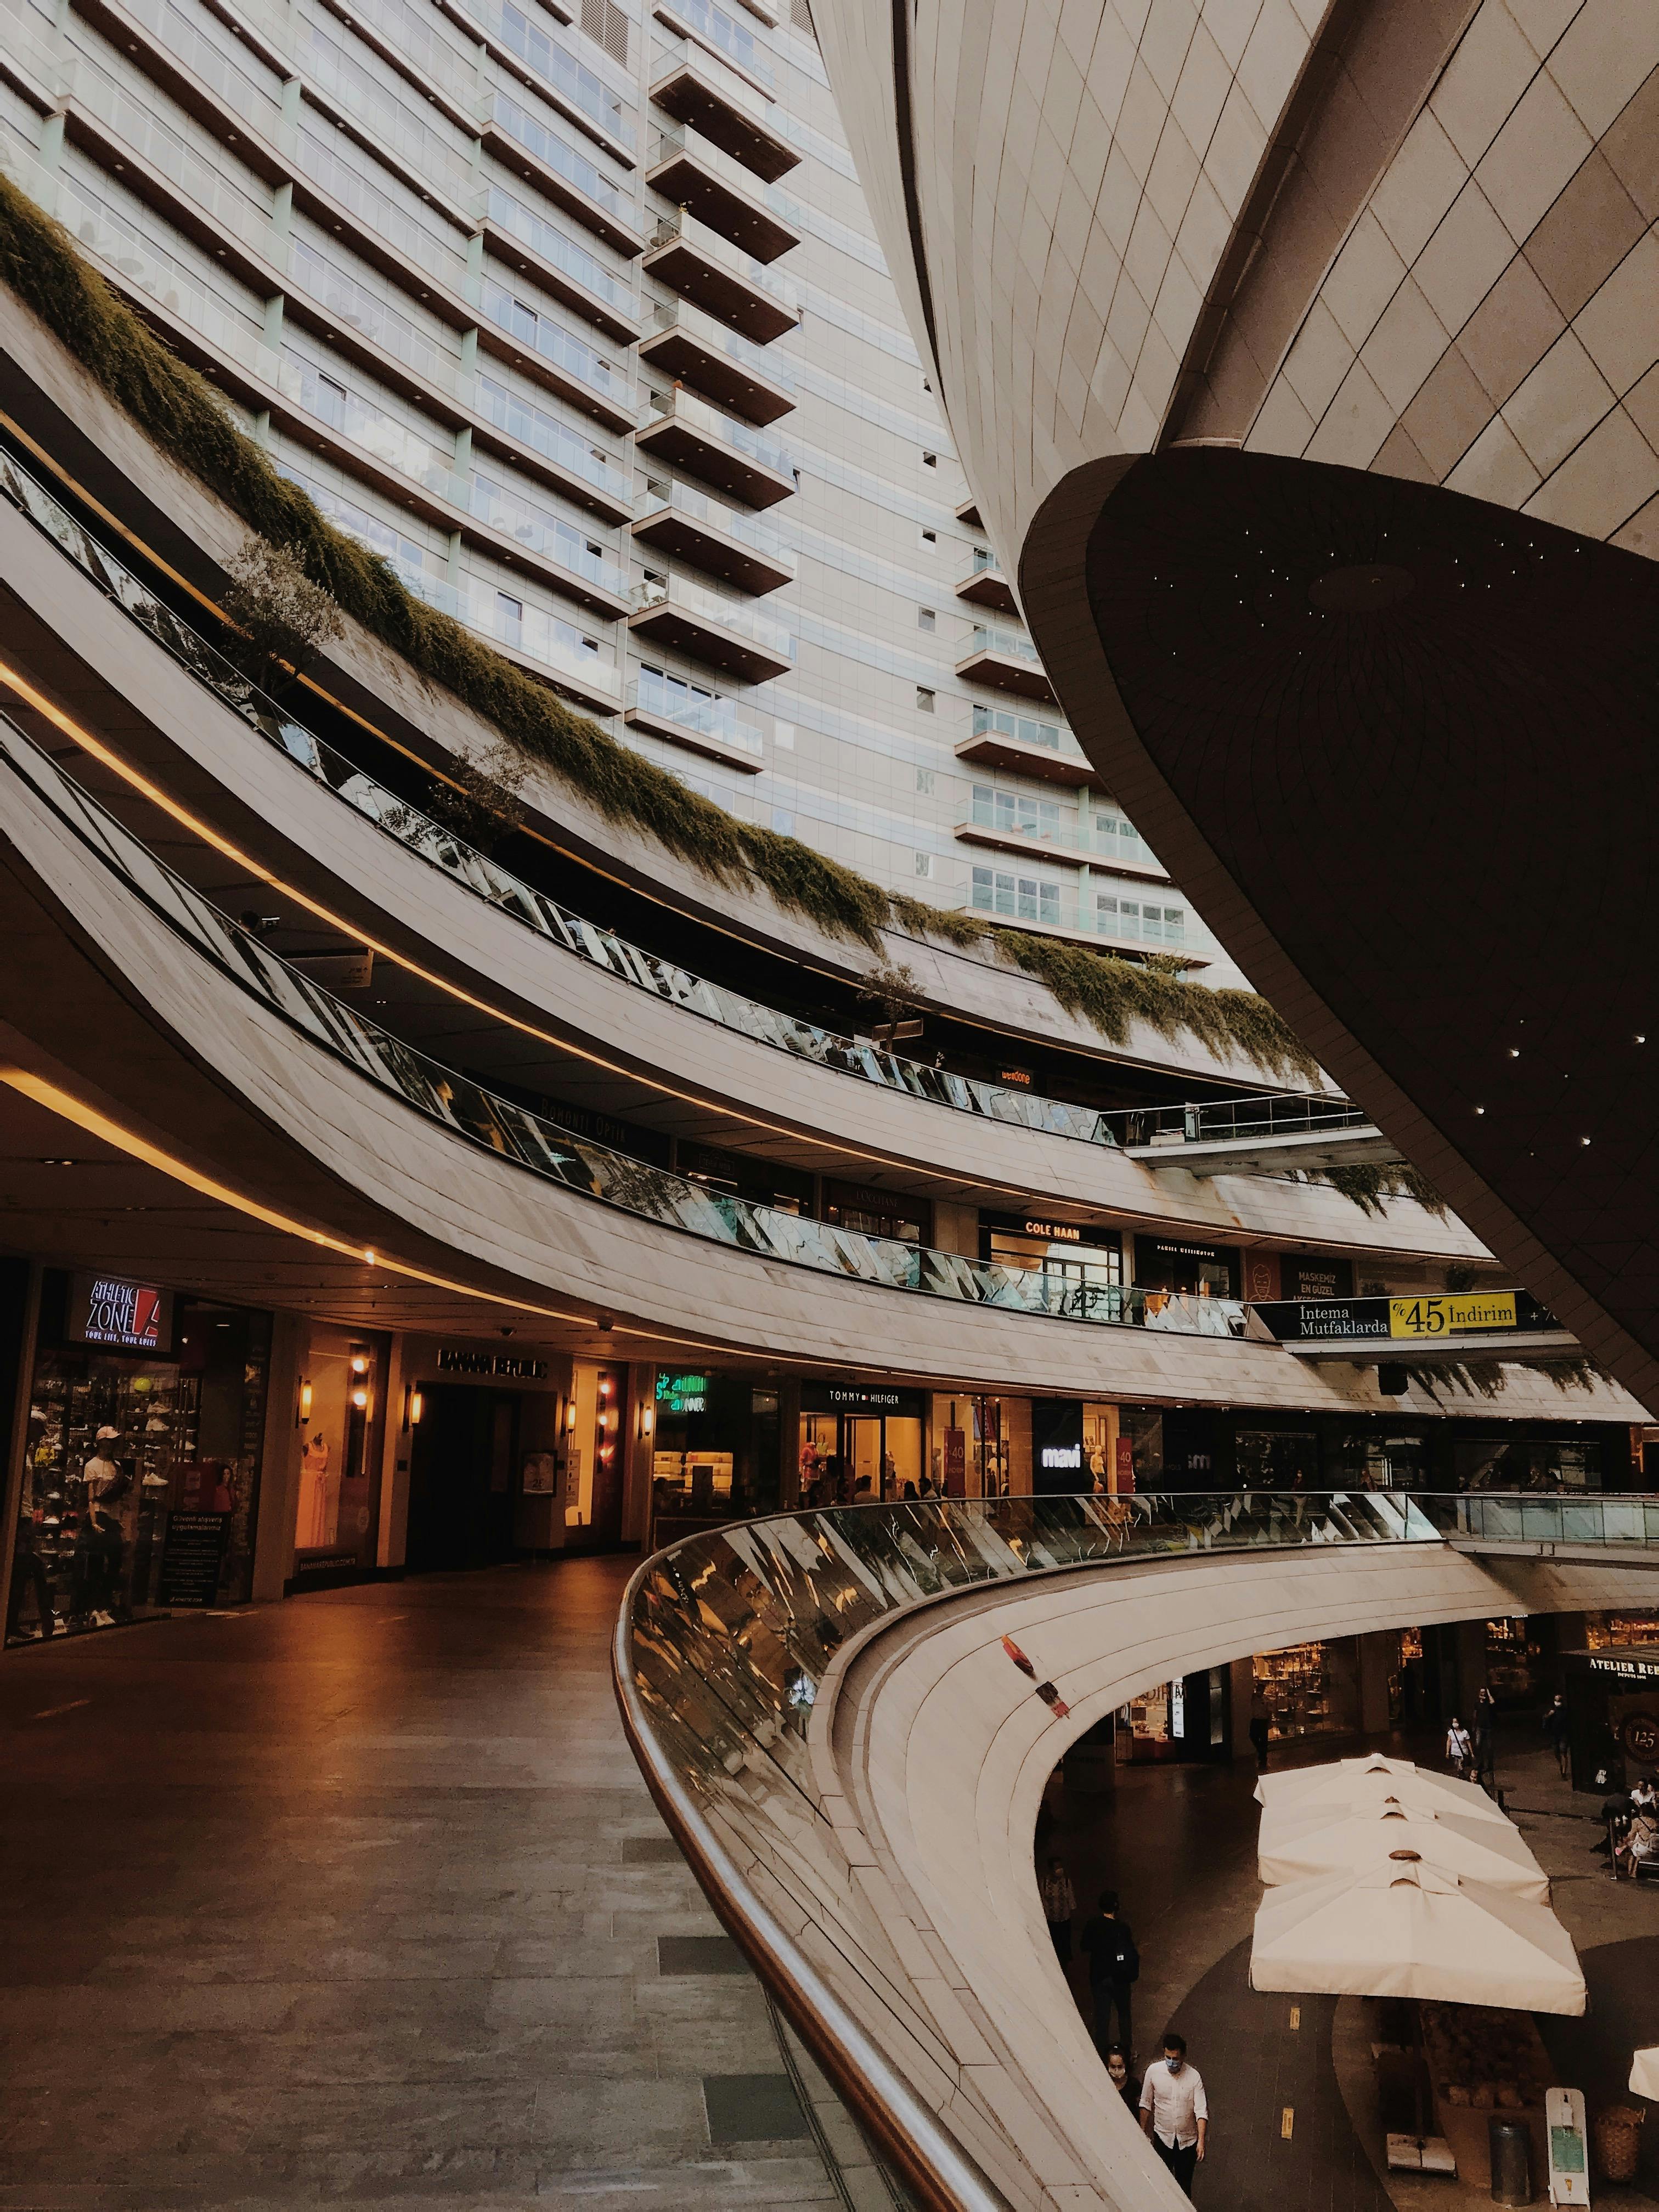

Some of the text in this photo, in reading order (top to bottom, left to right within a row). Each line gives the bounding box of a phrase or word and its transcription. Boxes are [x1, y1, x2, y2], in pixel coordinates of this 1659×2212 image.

[1026, 1222, 1080, 1240] COLE HAAN
[91, 1280, 137, 1305] ATHLETIC
[1301, 1283, 1335, 1295] EN GÜZEL
[86, 1298, 133, 1334] ZONE
[1300, 1305, 1350, 1319] İntema
[1448, 1305, 1513, 1323] İndirim
[1300, 1319, 1389, 1335] Mutfaklarda
[437, 1348, 548, 1379] BANANA REPUBLIC
[830, 1390, 899, 1404] TOMMY HILFIGER
[1042, 1443, 1081, 1468] mavi
[1590, 1658, 1635, 1673] ATELIER
[1635, 1731, 1655, 1748] 125
